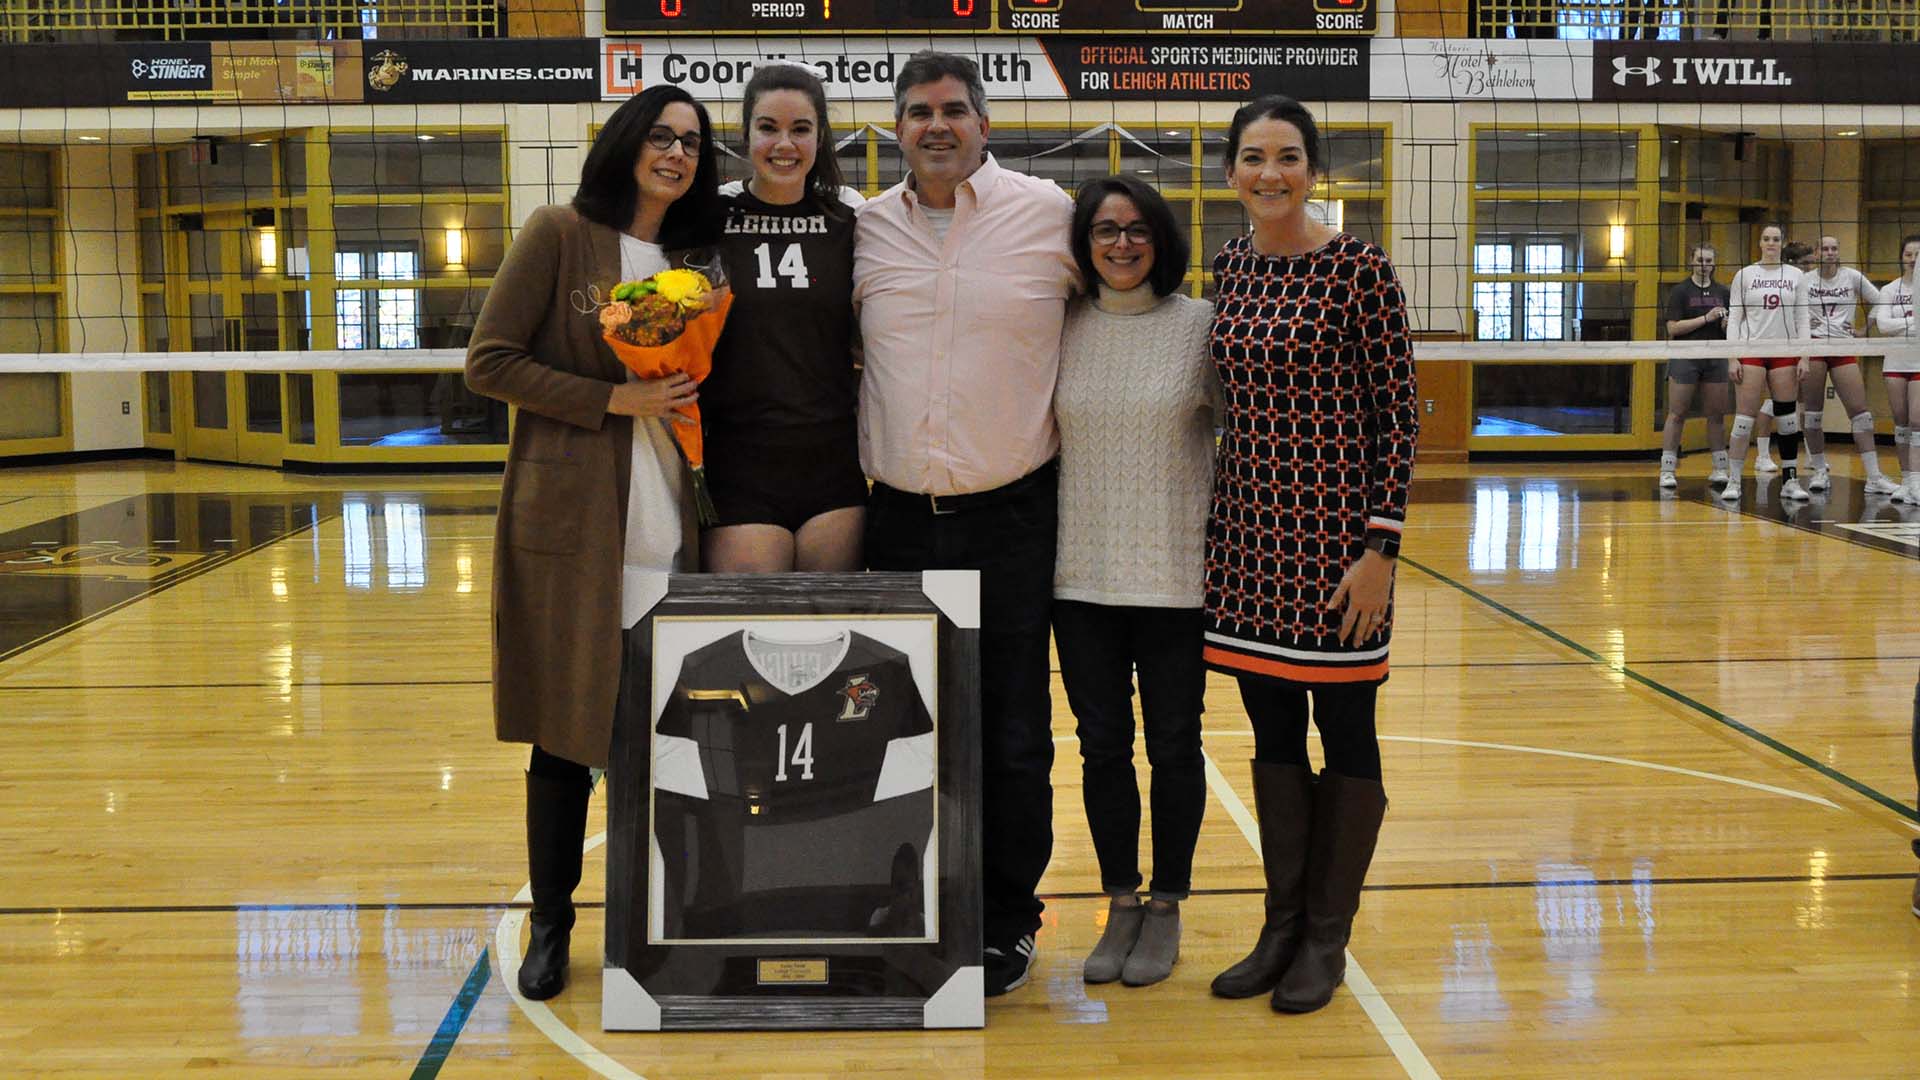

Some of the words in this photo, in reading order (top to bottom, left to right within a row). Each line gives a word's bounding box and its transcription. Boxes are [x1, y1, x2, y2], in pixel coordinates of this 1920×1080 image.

[752, 3, 805, 17] PERIOD
[1011, 13, 1060, 29] SCORE
[1163, 14, 1214, 29] MATCH
[1316, 14, 1364, 29] SCORE
[222, 57, 246, 66] Fuel
[1081, 47, 1147, 65] OFFICIAL
[1151, 47, 1208, 65] SPORTS
[1212, 47, 1282, 65] MEDICINE
[1286, 48, 1358, 65] PROVIDER
[1433, 49, 1482, 78] Hotel
[148, 65, 206, 79] STINGER
[222, 70, 260, 80] Simple
[412, 68, 593, 81] MARINES.COM
[662, 53, 895, 83] Coorated
[1672, 58, 1688, 84] I
[1691, 58, 1792, 85] WILL.
[1081, 71, 1109, 90] FOR
[1113, 72, 1166, 90] LEHIGH
[1170, 72, 1250, 90] ATHLETICS
[1456, 69, 1535, 95] Bethlehem
[754, 243, 809, 288] 14
[1751, 279, 1794, 291] AMERICAN
[1763, 294, 1780, 310] 19
[775, 722, 815, 781] 14
